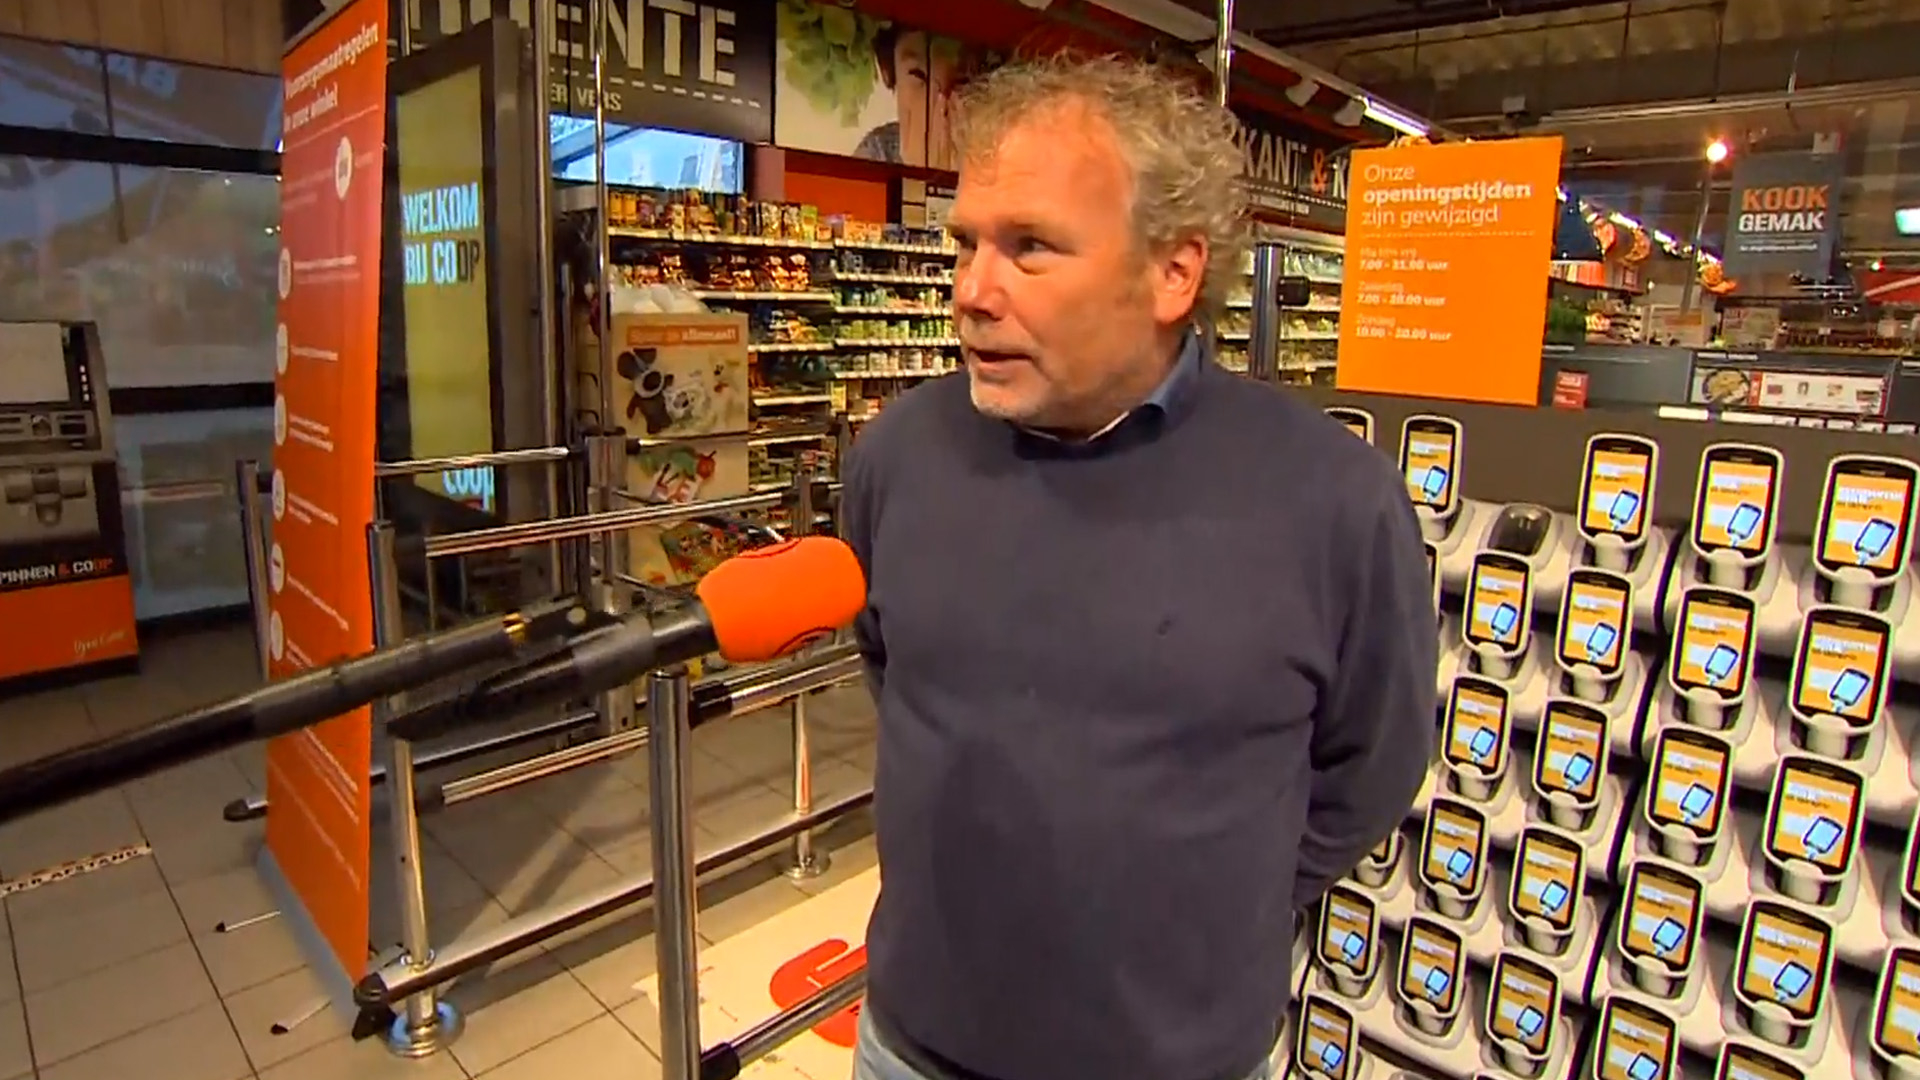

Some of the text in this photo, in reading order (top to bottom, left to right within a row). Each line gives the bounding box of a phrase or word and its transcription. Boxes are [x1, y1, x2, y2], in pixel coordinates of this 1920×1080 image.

[1363, 164, 1415, 183] Onze
[1363, 181, 1532, 207] openingstijden
[1740, 185, 1829, 212] KOOK
[402, 182, 479, 236] WELKOM
[1361, 203, 1499, 229] zijn gewijzigd
[1738, 211, 1825, 232] GEMAK
[405, 243, 428, 284] BIJ
[432, 240, 480, 284] COOP
[0, 564, 56, 585] PINNEN
